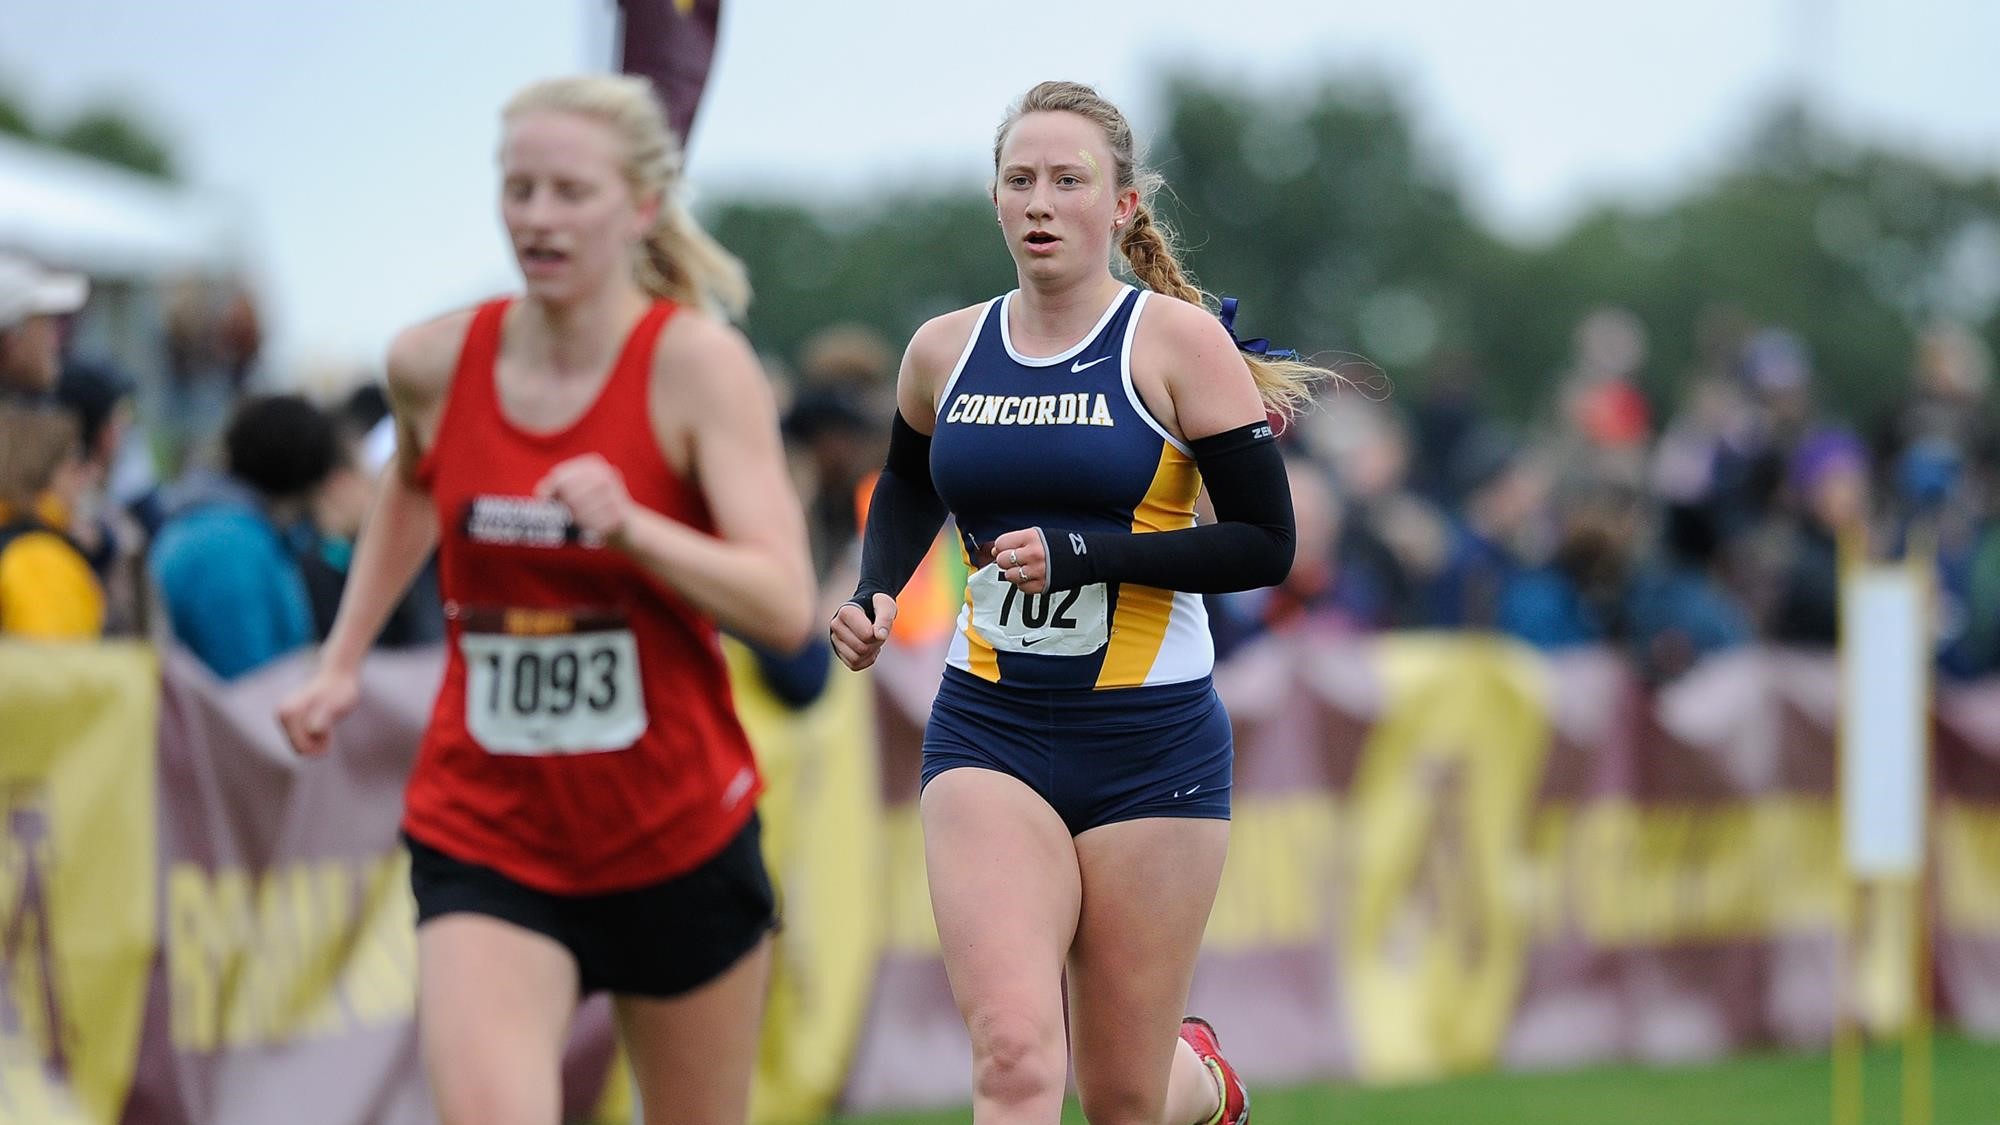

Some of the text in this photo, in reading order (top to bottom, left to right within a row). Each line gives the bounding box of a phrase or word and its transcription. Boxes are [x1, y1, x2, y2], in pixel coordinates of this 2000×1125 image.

[946, 393, 1114, 427] CONCORDIA
[998, 571, 1077, 629] 702
[487, 648, 617, 715] 1093
